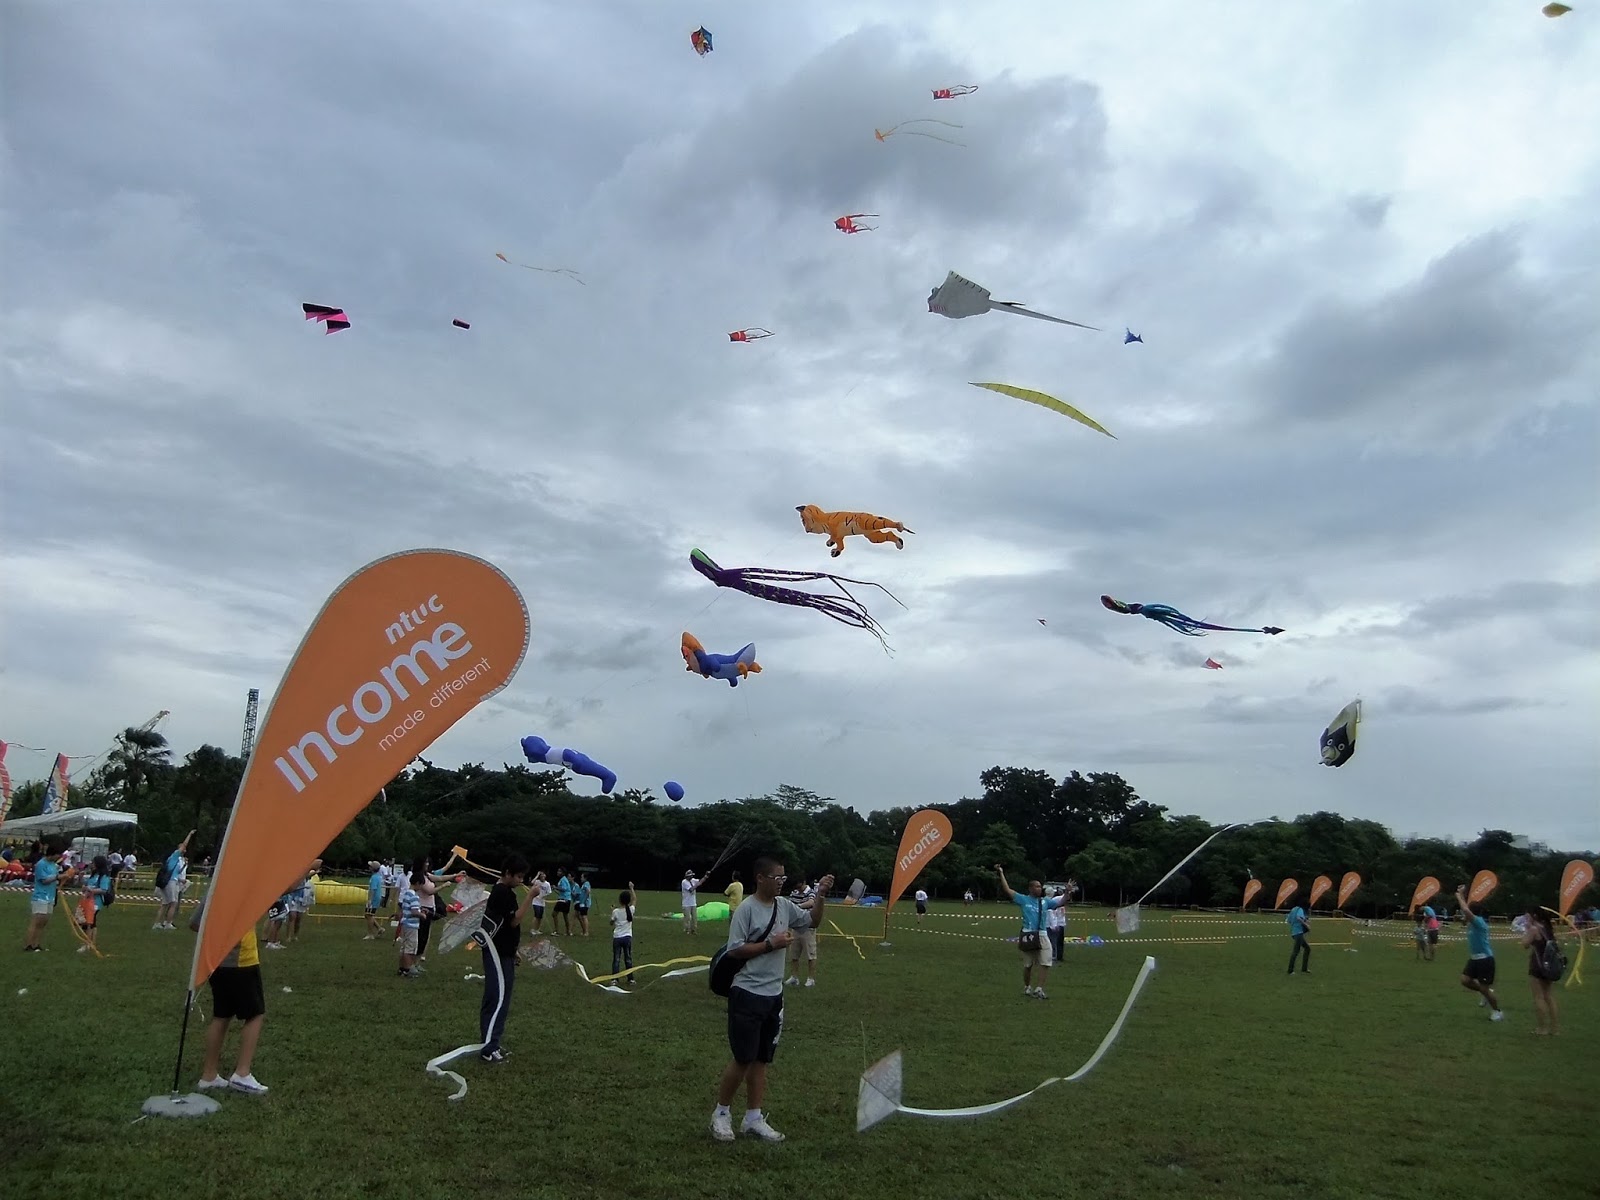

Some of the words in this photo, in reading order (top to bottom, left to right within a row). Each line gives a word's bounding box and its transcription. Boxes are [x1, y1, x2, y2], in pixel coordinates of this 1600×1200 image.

[385, 593, 444, 644] ntuc
[378, 709, 426, 751] made
[429, 656, 492, 709] different
